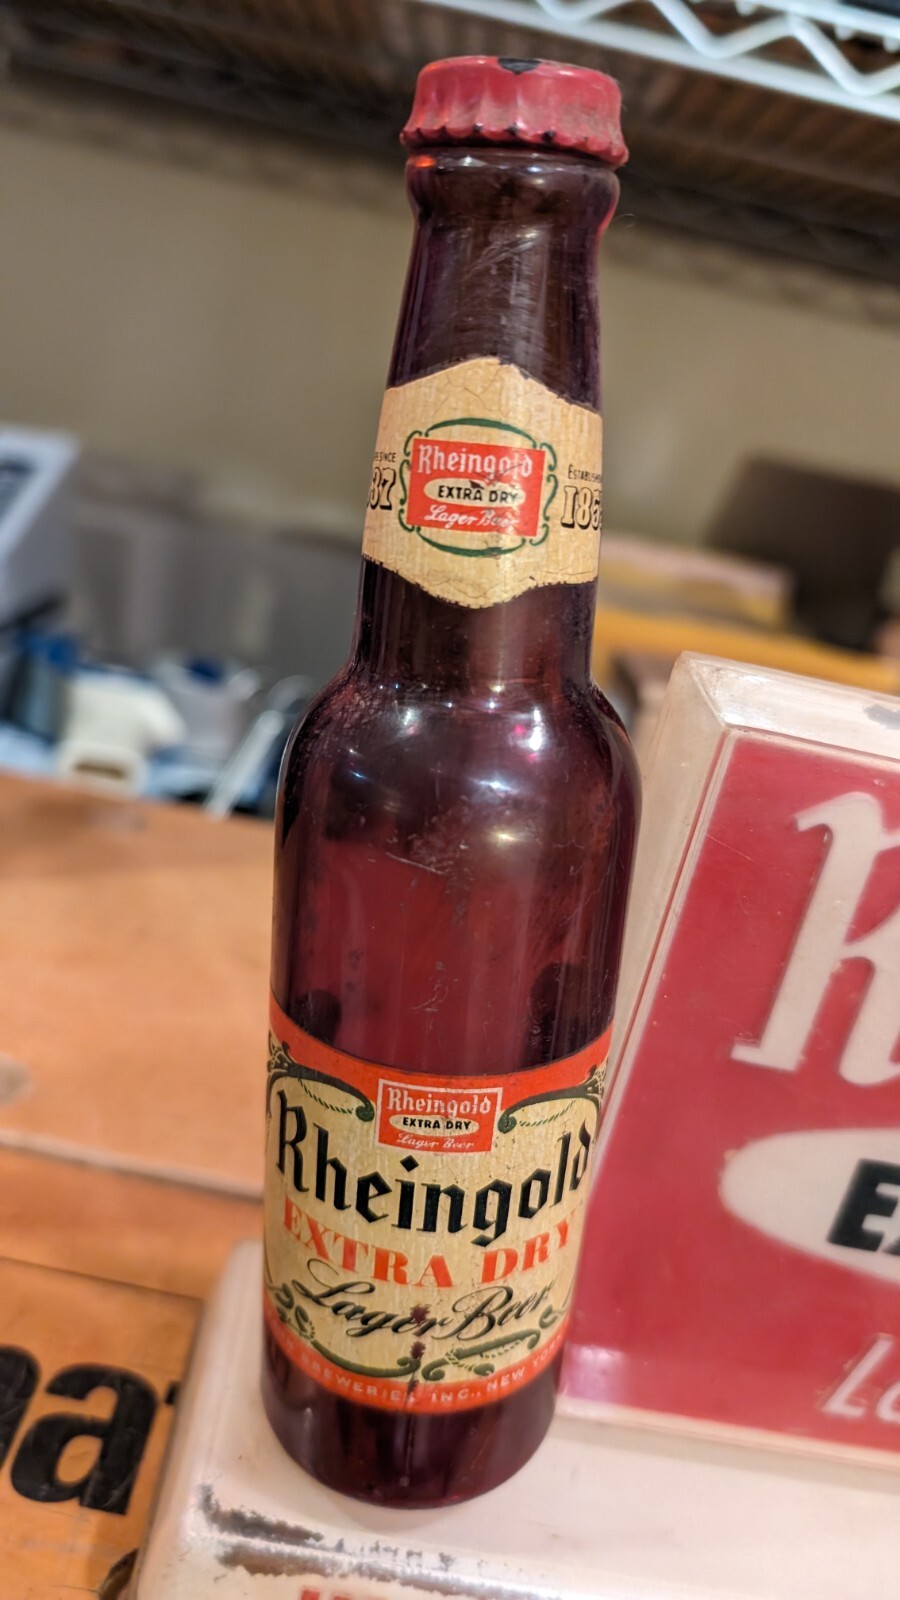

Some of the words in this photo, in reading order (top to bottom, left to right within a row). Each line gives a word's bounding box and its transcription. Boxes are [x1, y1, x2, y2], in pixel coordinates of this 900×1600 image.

[418, 444, 533, 483] Rheingold
[367, 466, 397, 511] 37
[438, 484, 482, 502] EXTRA
[488, 490, 518, 505] DRY
[424, 504, 478, 529] Lager
[387, 1087, 492, 1119] Rheingold
[402, 1116, 441, 1130] EXTRA
[445, 1120, 472, 1130] DRY
[396, 1132, 439, 1149] Lager
[442, 1137, 475, 1149] Beer
[276, 1089, 591, 1247] Rheingold
[283, 1195, 454, 1288] EXTRA
[479, 1208, 576, 1285] DRY
[292, 1258, 453, 1338] Lager
[431, 1276, 556, 1341] Beer
[486, 1366, 526, 1393] NEW
